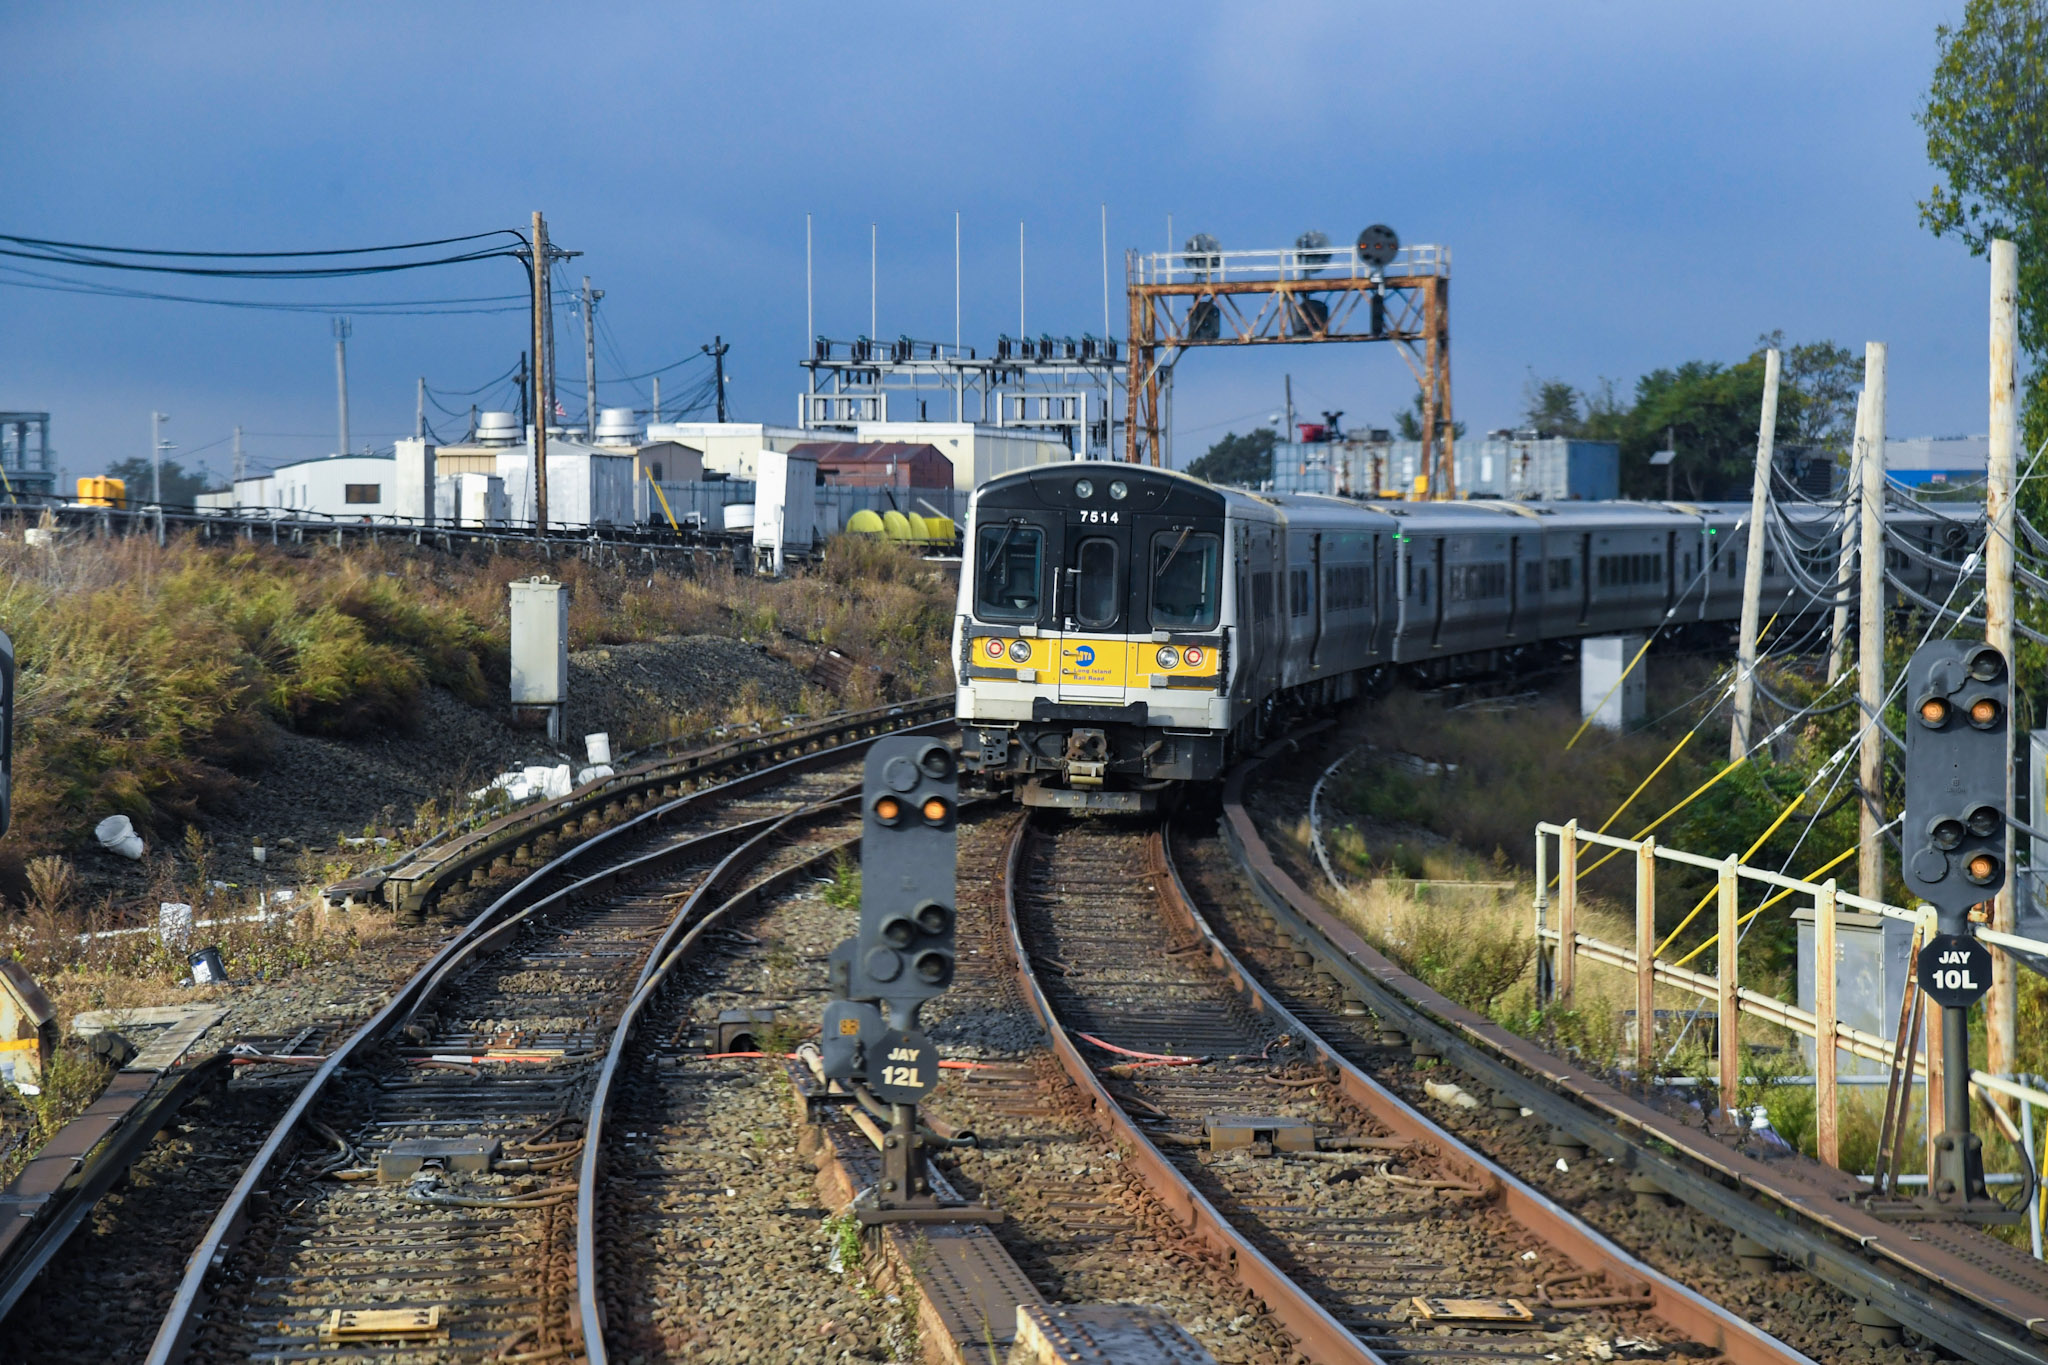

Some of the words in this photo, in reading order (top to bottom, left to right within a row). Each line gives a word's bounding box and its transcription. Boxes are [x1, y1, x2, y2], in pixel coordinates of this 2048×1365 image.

[1080, 510, 1119, 524] 7514
[1939, 951, 1971, 964] JAY
[1932, 970, 1978, 990] 10L
[888, 1048, 920, 1062] JAY
[881, 1066, 924, 1088] 12L
